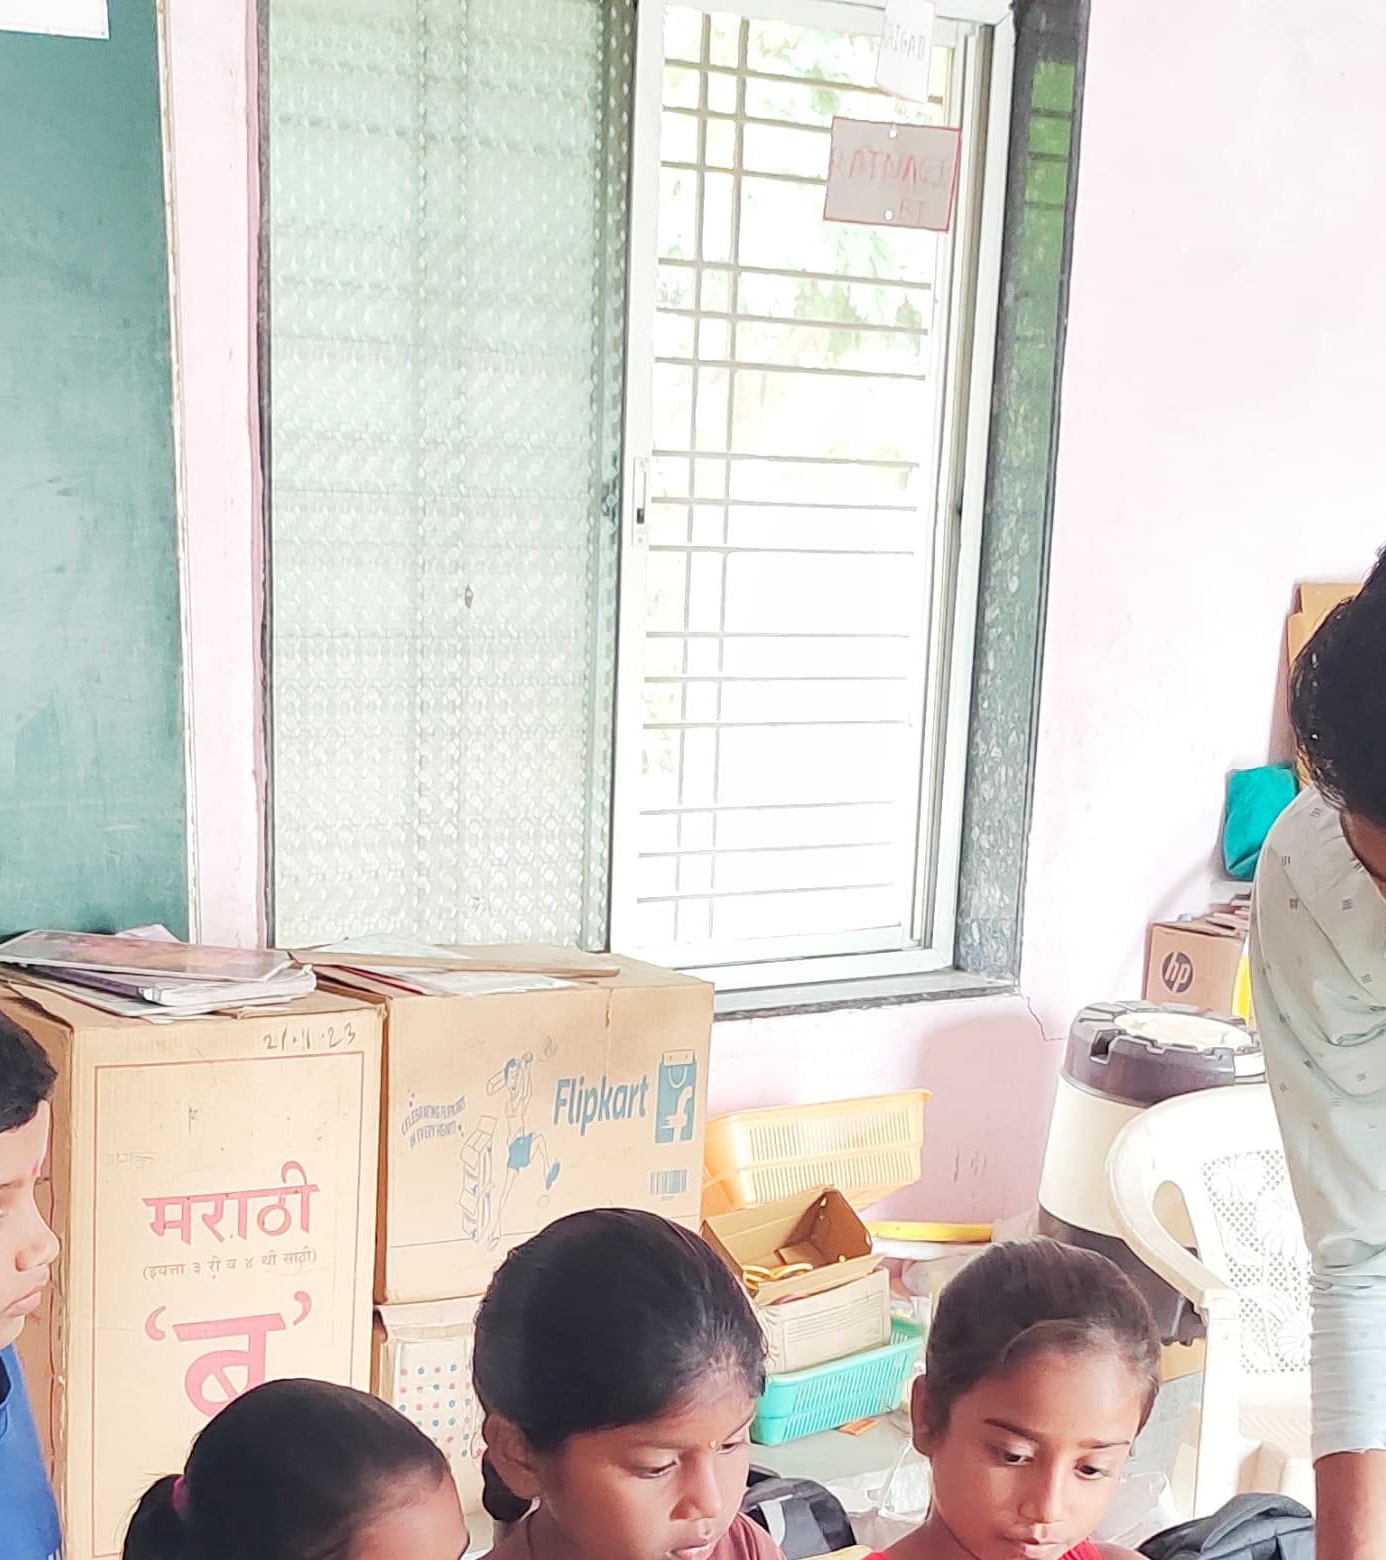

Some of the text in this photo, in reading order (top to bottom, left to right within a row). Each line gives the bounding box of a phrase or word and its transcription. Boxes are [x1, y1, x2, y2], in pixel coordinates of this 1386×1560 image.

[1164, 953, 1192, 992] hp
[553, 1075, 651, 1137] Flipkart
[141, 1160, 320, 1246] मराठी
[193, 1264, 201, 1273] ३
[244, 1257, 254, 1268] ४
